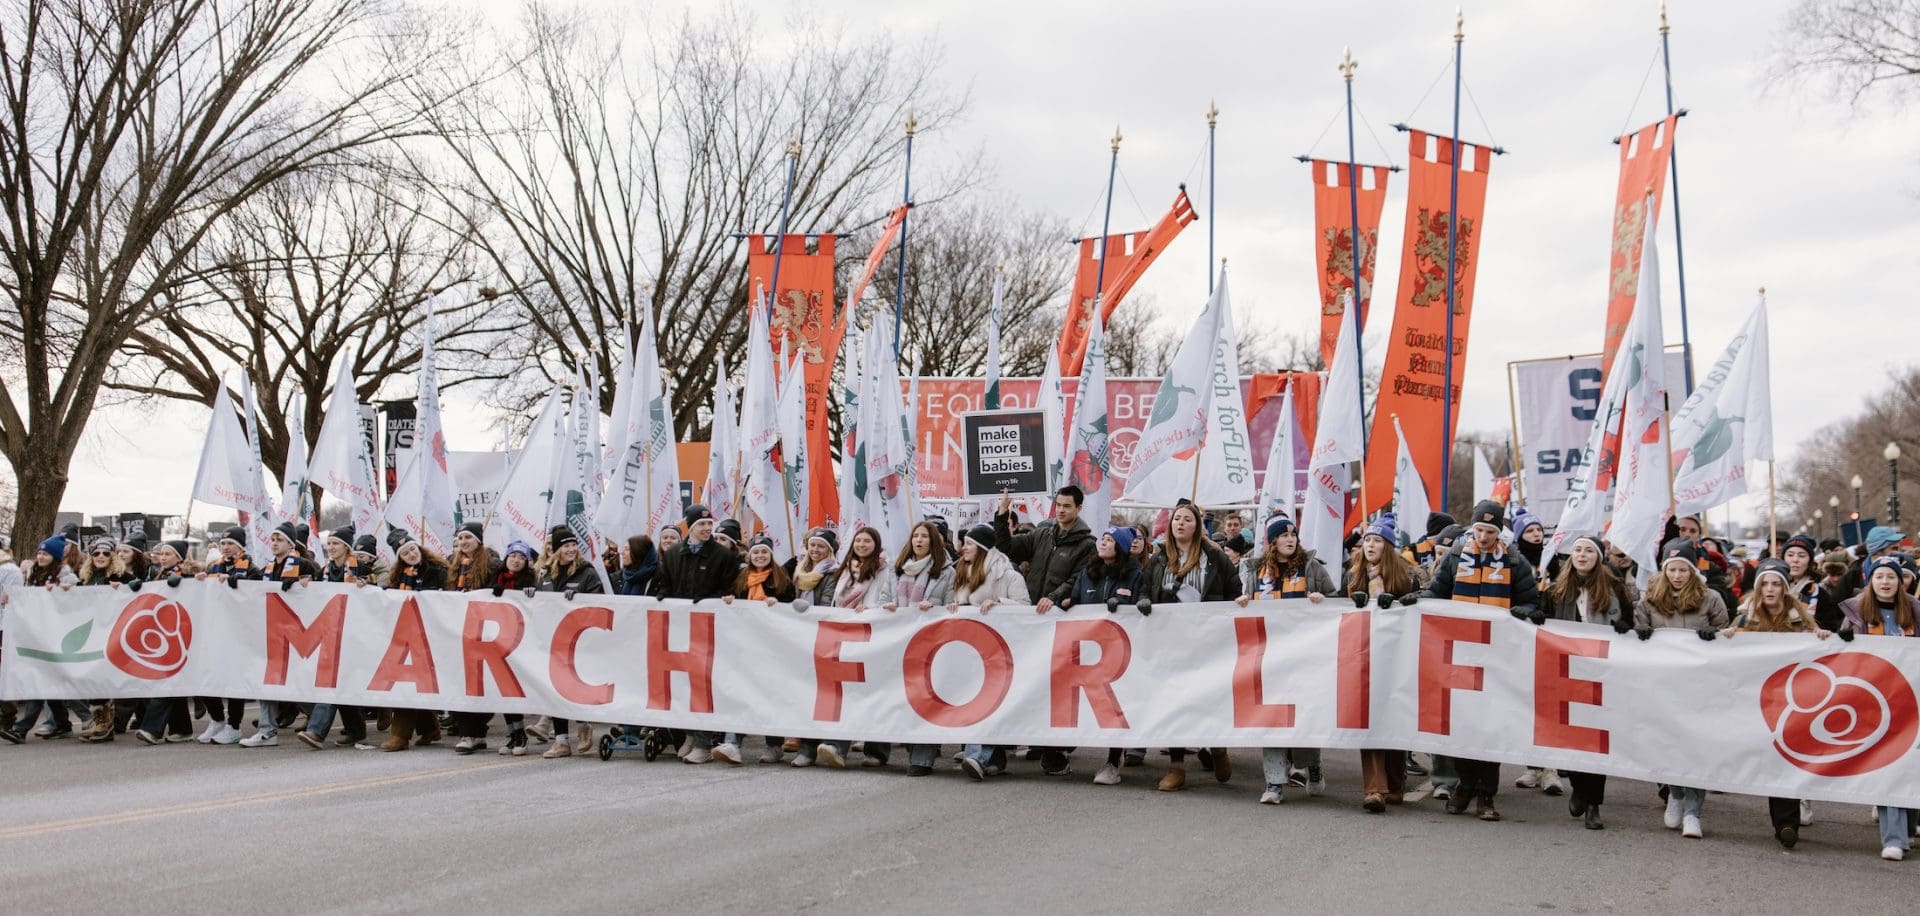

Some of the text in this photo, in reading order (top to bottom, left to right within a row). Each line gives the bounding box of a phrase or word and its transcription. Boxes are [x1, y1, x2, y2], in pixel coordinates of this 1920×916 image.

[1115, 393, 1155, 419] BE
[980, 427, 1018, 441] make
[981, 444, 1018, 455] more
[982, 458, 1032, 472] babies.
[1537, 448, 1583, 475] SA
[265, 592, 1609, 754] MARCH FOR LIFE
